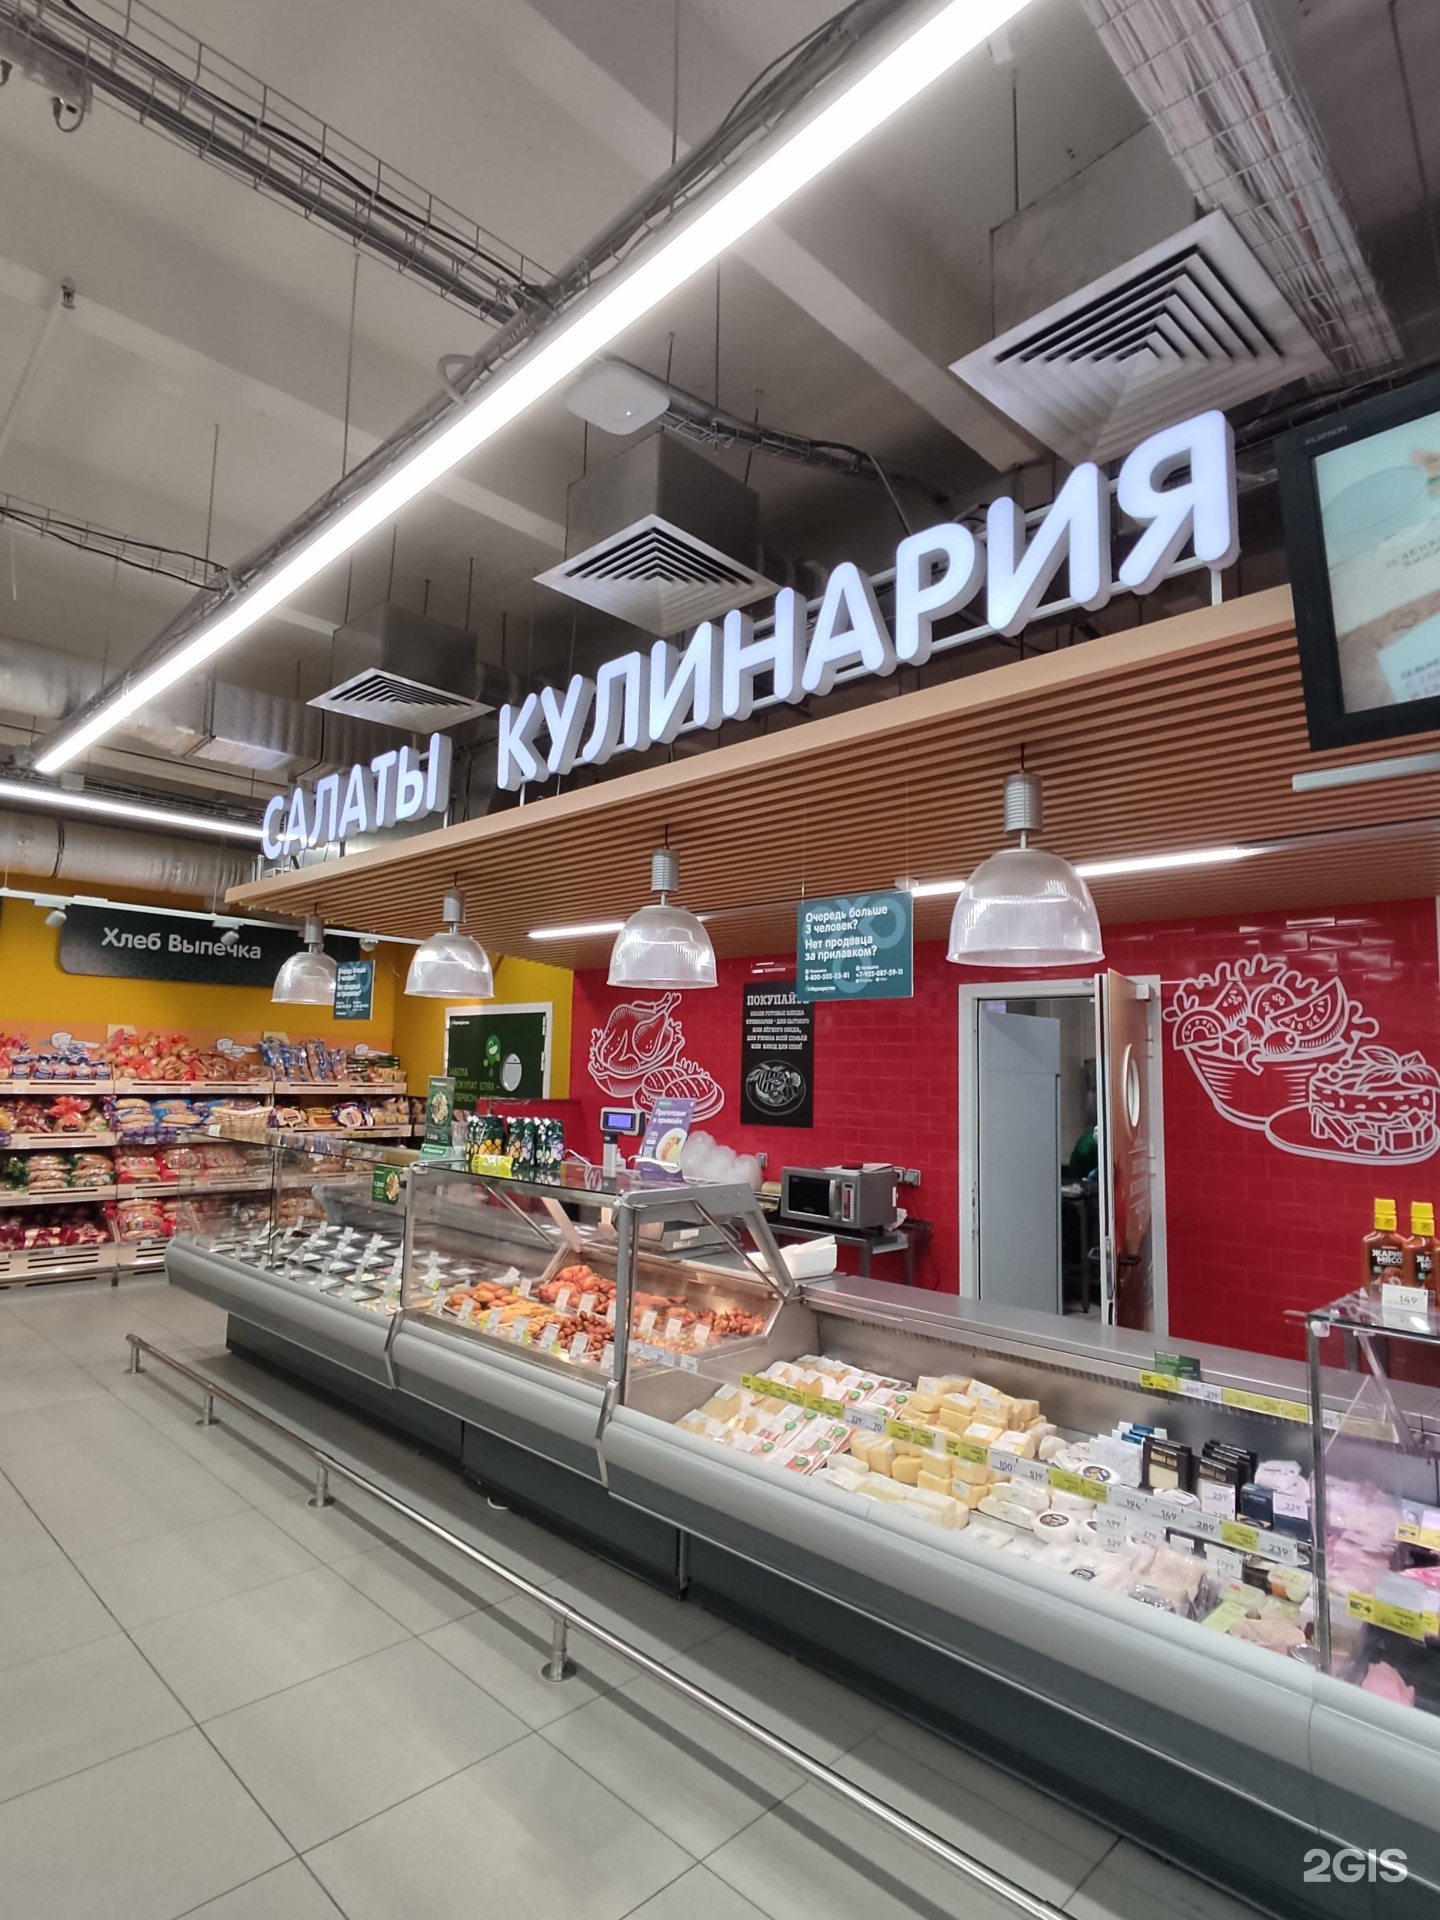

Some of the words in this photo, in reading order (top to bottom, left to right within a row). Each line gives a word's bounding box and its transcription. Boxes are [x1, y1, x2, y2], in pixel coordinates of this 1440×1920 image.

[497, 410, 1238, 790] КУЛИНАРИЯ
[262, 732, 450, 860] САЛАТЫ
[805, 911, 847, 923] Очередь
[849, 905, 888, 917] больше
[805, 925, 811, 934] 3
[814, 919, 858, 933] человек?
[101, 927, 162, 950] Хлеб
[168, 934, 262, 959] Выпечка
[805, 939, 823, 949] Нет
[825, 935, 873, 948] продавца
[805, 952, 815, 961] за
[817, 945, 877, 962] прилавком?
[1400, 1295, 1417, 1305] 149
[999, 1461, 1013, 1472] 100
[1126, 1499, 1141, 1510] 194
[1162, 1510, 1177, 1521] 149
[1197, 1521, 1215, 1532] 289
[1269, 1543, 1289, 1556] 239
